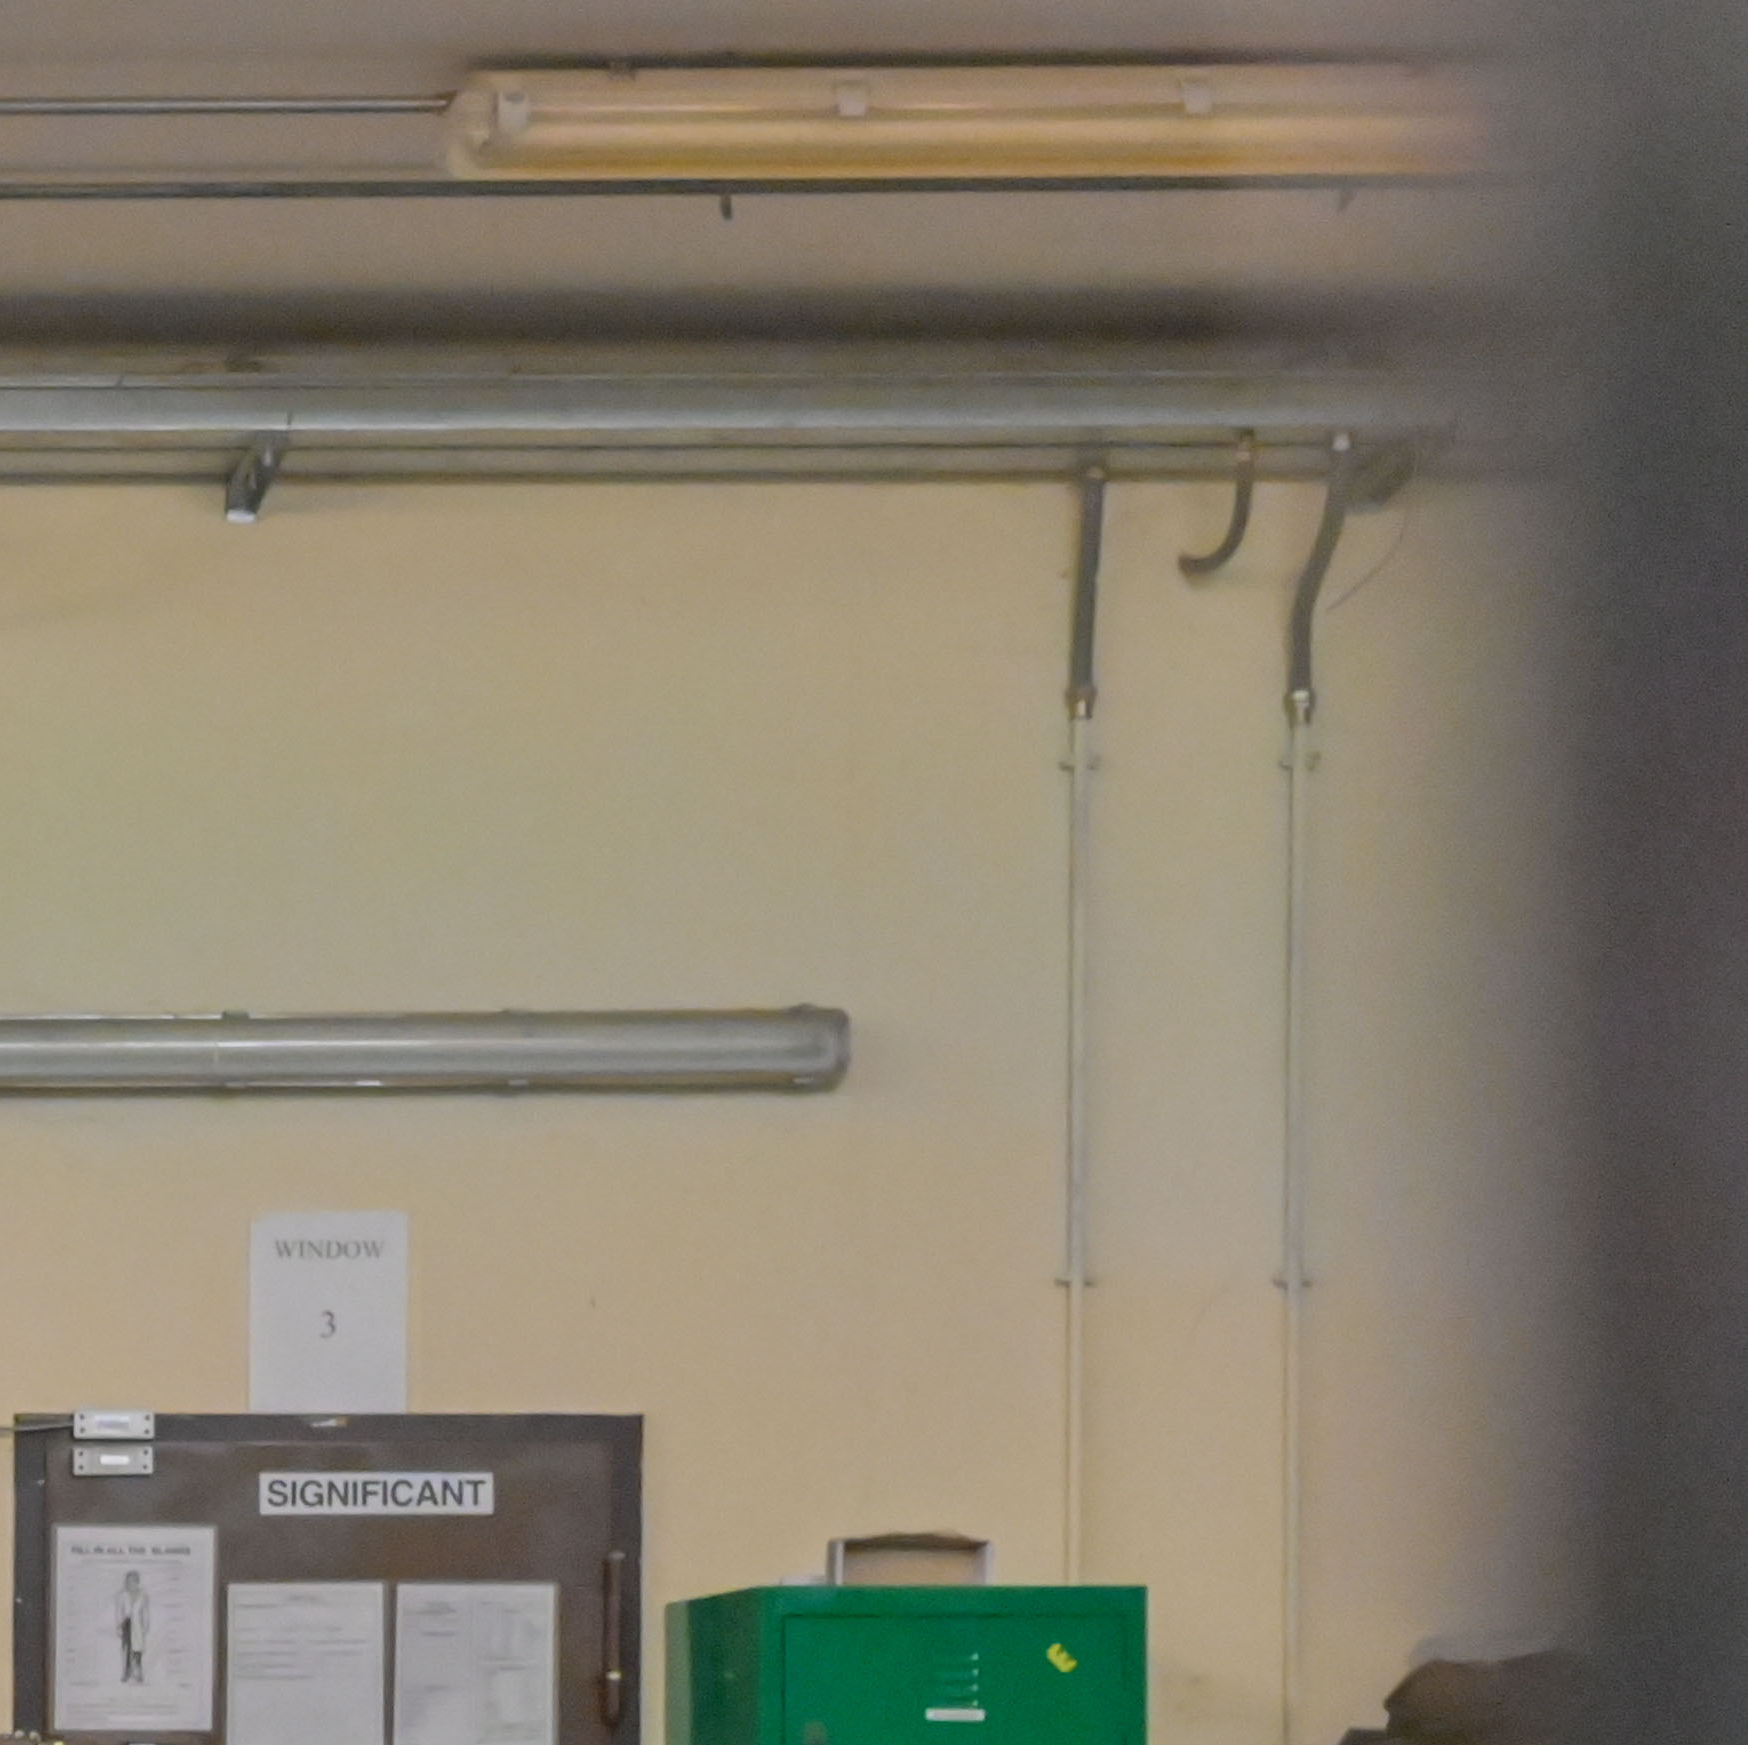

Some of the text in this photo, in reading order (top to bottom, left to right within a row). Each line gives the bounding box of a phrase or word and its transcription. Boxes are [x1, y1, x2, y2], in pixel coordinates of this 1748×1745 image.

[274, 1239, 384, 1259] WINDOW
[319, 1310, 337, 1339] 3
[267, 1479, 486, 1507] SIGNIFICANT
